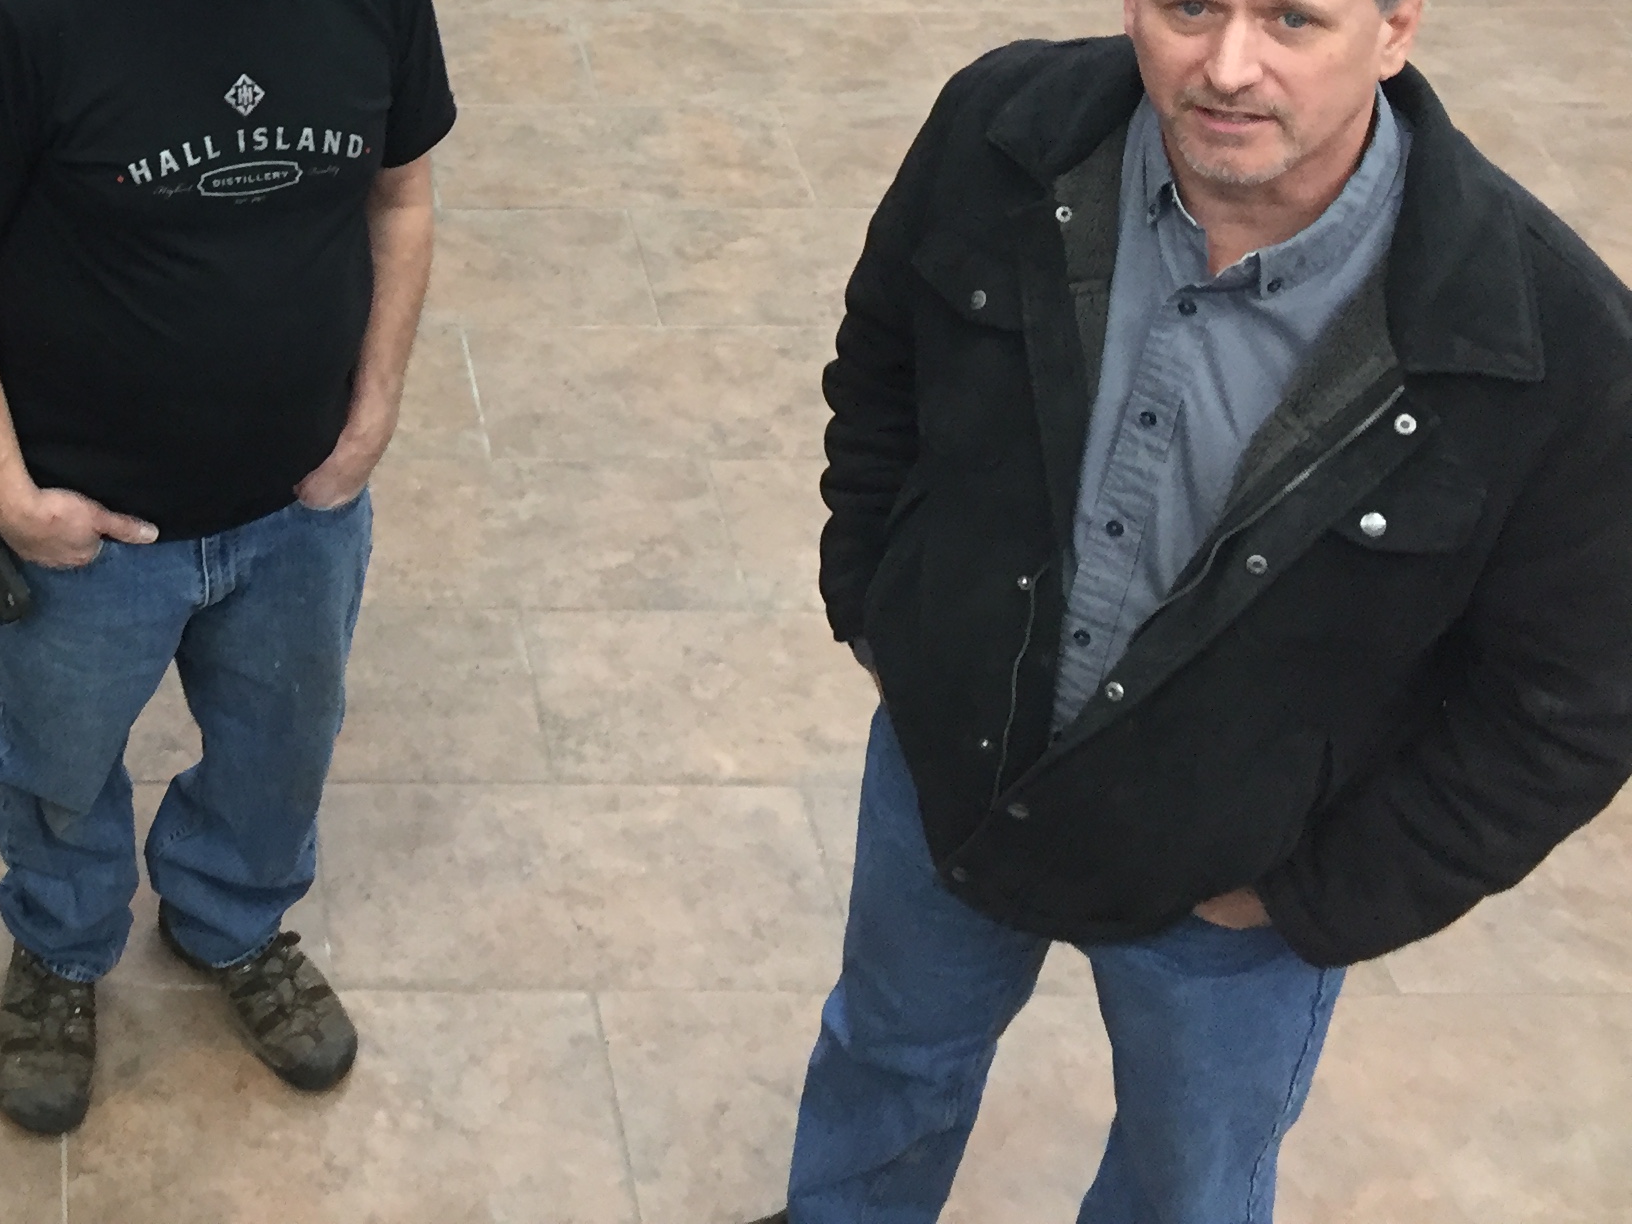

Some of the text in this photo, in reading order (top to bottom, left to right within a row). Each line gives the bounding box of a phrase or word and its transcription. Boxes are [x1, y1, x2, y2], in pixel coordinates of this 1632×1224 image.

[128, 126, 364, 185] HALL ISLAND
[212, 170, 289, 188] DISTILLERY
